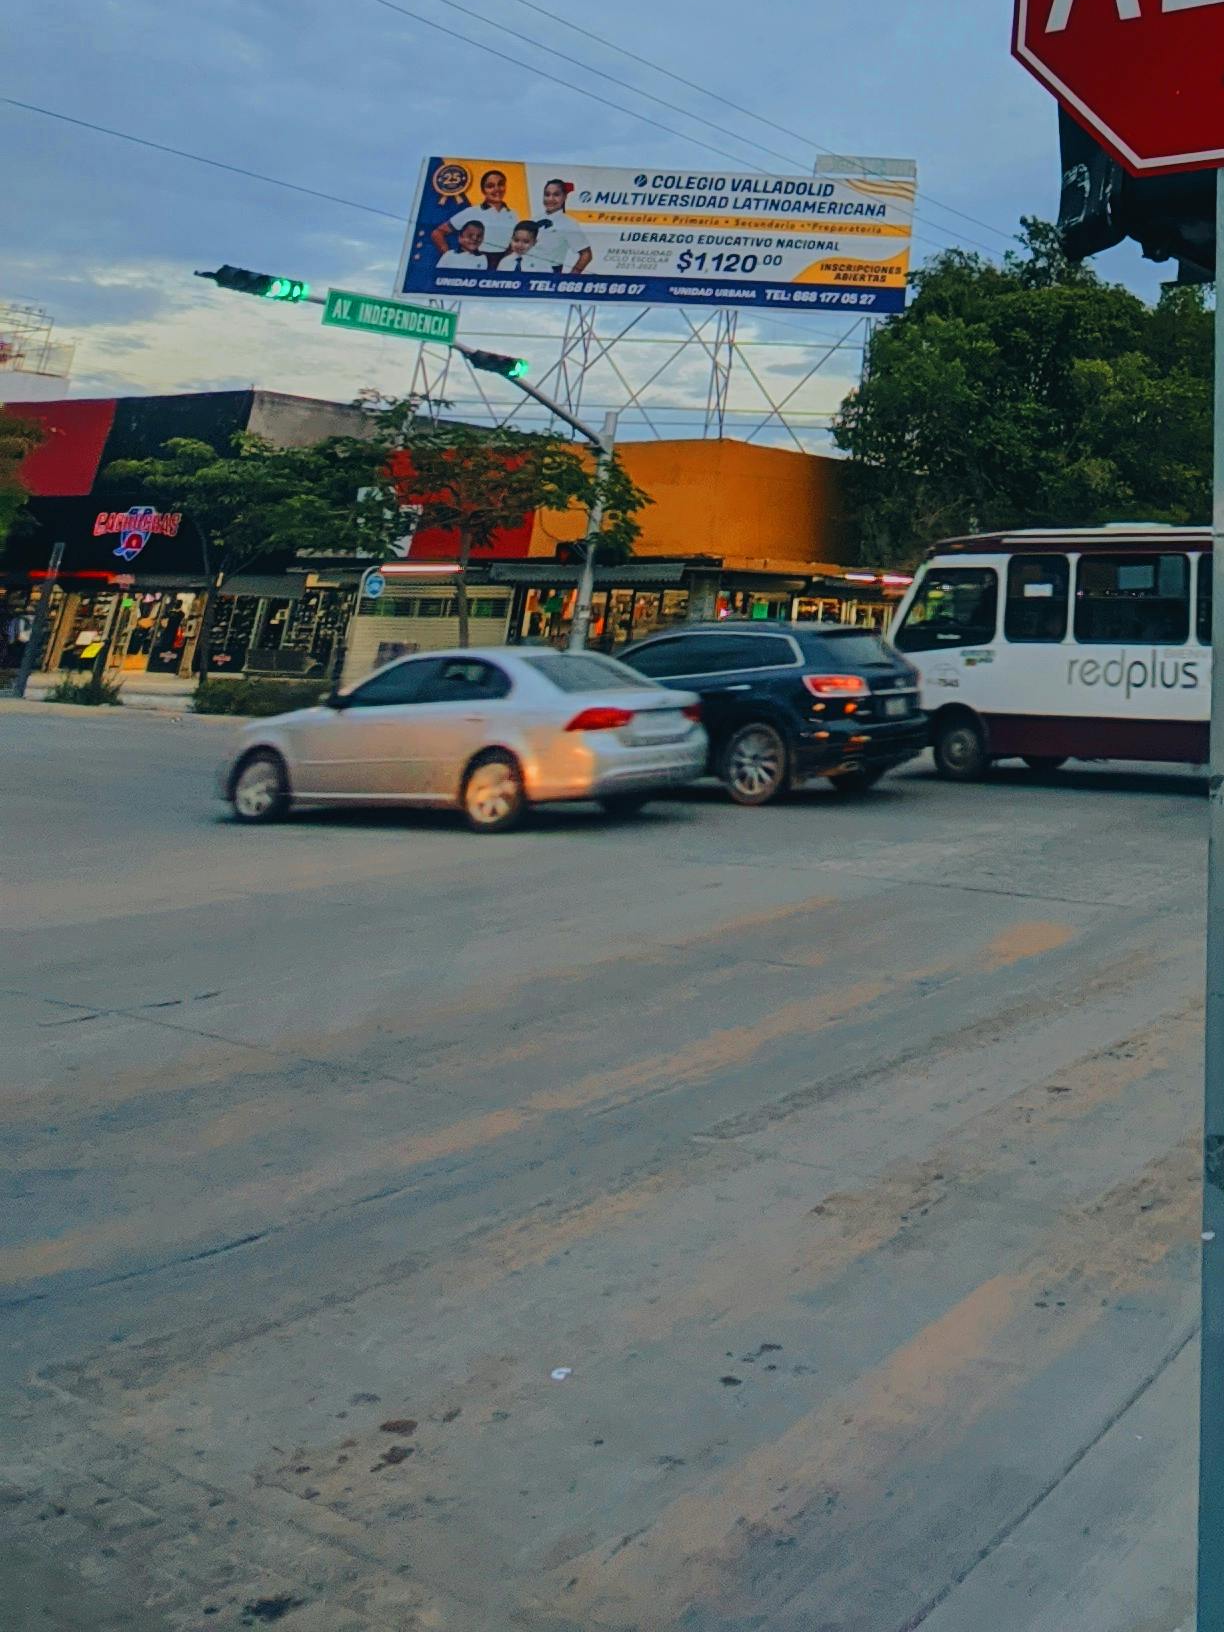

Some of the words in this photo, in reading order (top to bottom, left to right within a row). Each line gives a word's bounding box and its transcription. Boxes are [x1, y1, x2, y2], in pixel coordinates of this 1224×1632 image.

[652, 175, 726, 191] COLEGIO
[731, 178, 835, 197] VALLADOLID
[594, 191, 729, 209] MULTIVERSIDAD
[732, 197, 887, 217] LATINOAMERICANA
[597, 213, 658, 223] Preescolar
[672, 215, 720, 225] Primaria
[735, 218, 796, 229] Secundaria
[619, 232, 694, 244] LIDERAZGO
[697, 234, 772, 247] EDUCATIVO
[776, 237, 840, 251] NACIONAL
[820, 263, 903, 275] INSCRIPCIONES
[435, 277, 475, 287] UNIDAD
[478, 279, 521, 289] CENTRO
[529, 280, 557, 292] TEL:
[833, 274, 887, 283] ABIERTAS
[714, 287, 757, 298] URBANA
[764, 288, 791, 301] TEL:
[819, 292, 840, 304] 177
[858, 294, 877, 305] 27
[332, 298, 352, 321] AV.
[359, 302, 450, 337] INDEPENDENCIA
[1067, 648, 1198, 699] redplus
